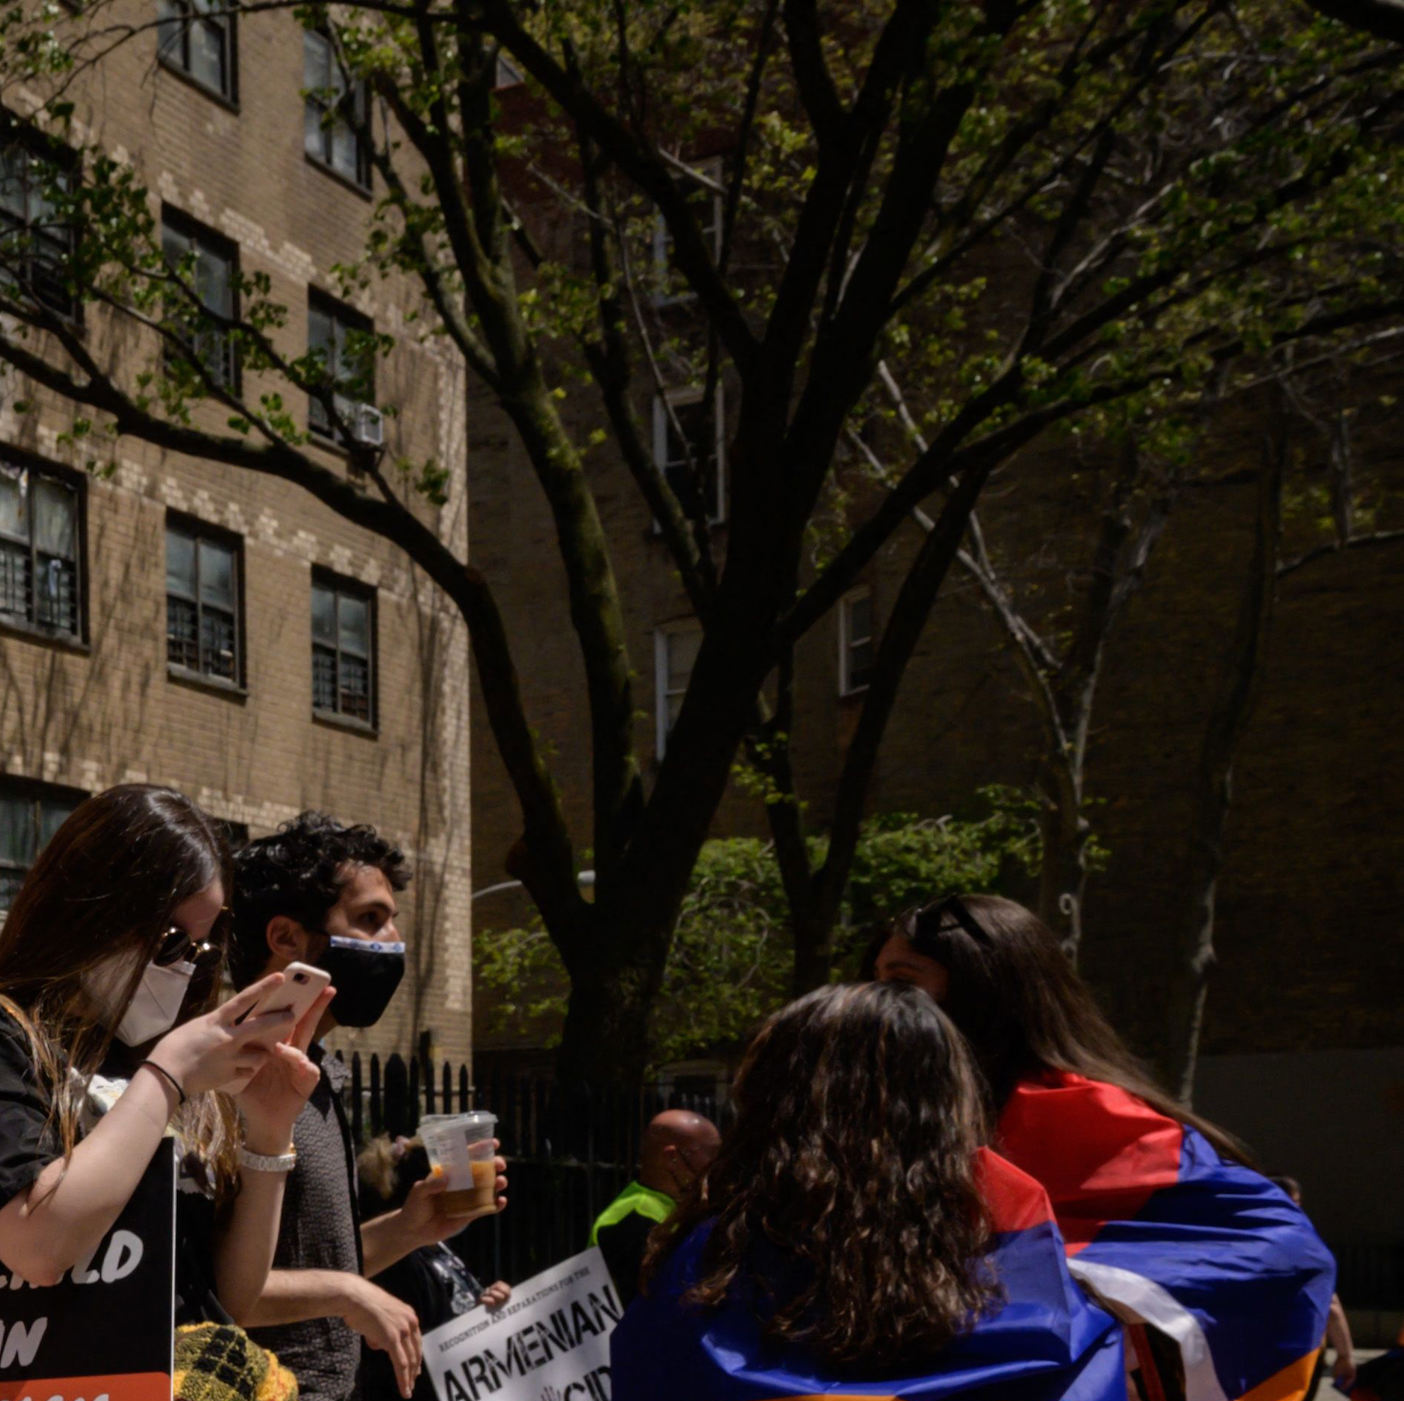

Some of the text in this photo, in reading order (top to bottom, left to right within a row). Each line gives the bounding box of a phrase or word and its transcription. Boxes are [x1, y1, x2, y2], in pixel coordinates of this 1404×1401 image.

[438, 1265, 591, 1352] RECOGNITION AND REPARATIONS FOR THE
